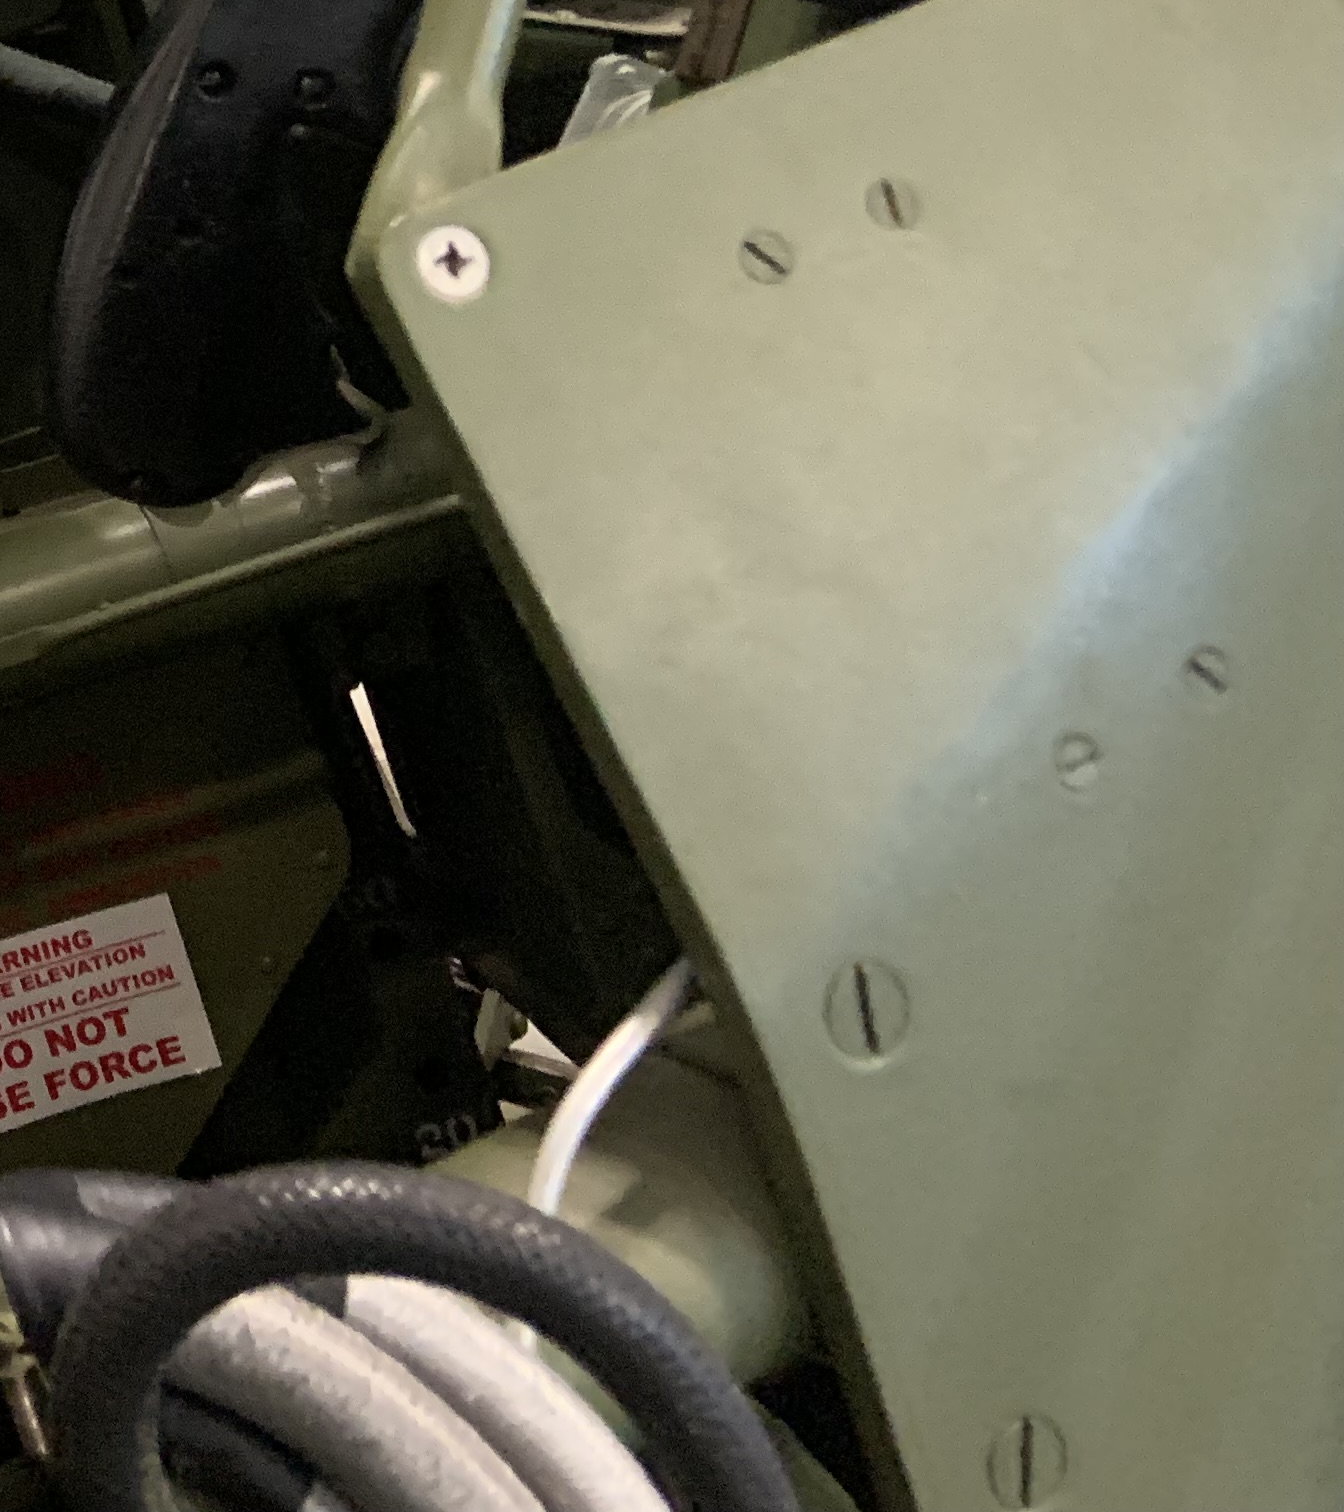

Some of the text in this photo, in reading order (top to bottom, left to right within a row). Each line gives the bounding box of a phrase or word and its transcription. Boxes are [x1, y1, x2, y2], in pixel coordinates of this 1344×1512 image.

[7, 996, 67, 1026] WITH
[72, 963, 176, 1007] CAUTION
[21, 941, 147, 993] ELEVATION
[44, 1007, 131, 1058] NOT
[43, 1034, 188, 1101] FORCE
